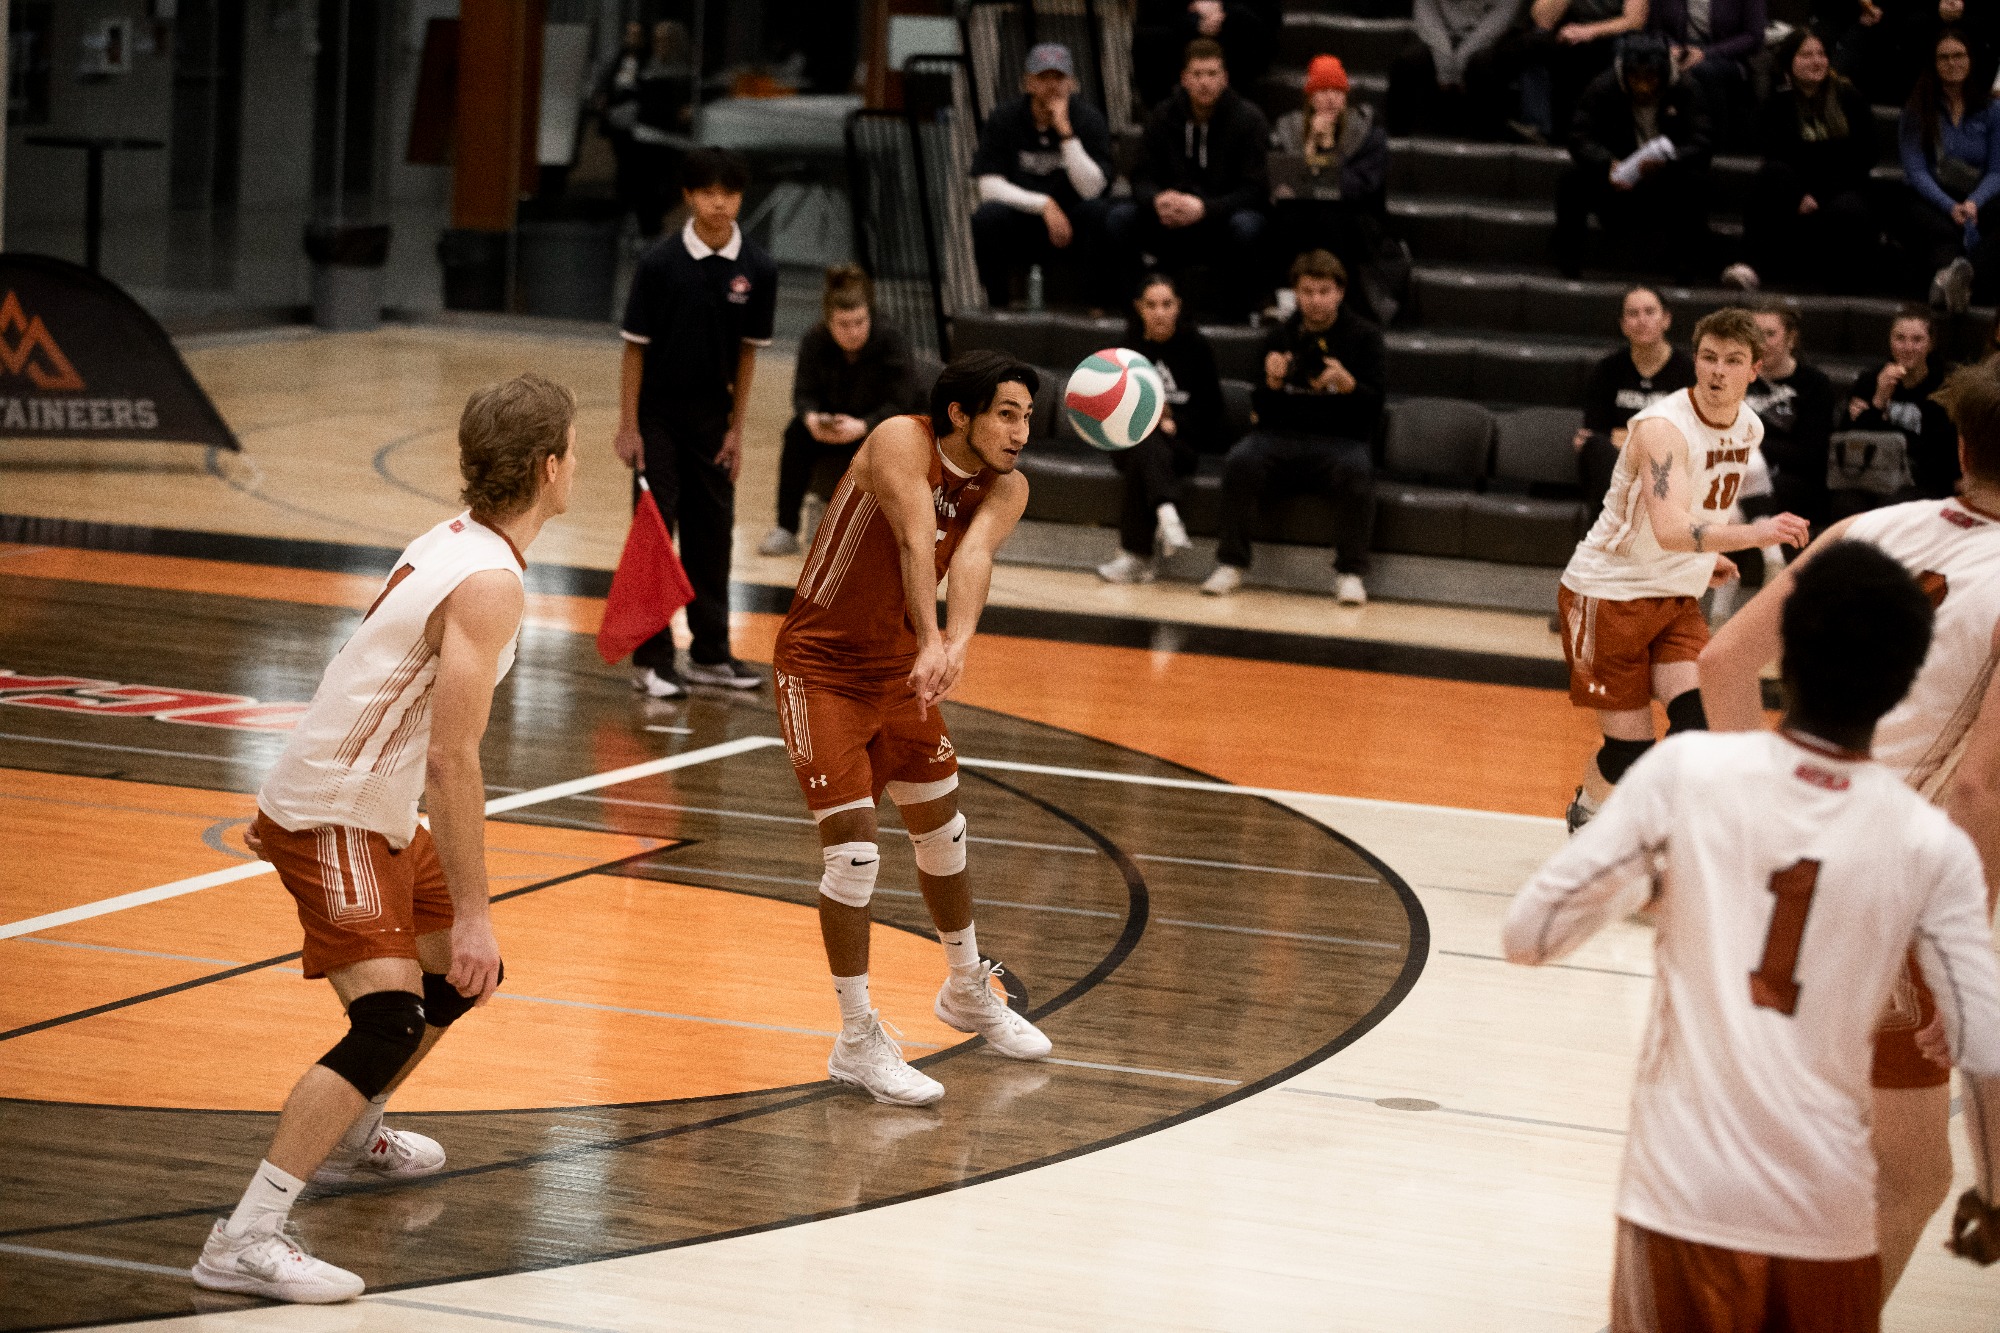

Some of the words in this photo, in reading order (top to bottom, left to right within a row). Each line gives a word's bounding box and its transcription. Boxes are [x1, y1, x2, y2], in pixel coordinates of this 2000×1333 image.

[0, 398, 158, 430] AINEERS
[1702, 472, 1741, 510] 10
[1748, 857, 1822, 1017] 1
